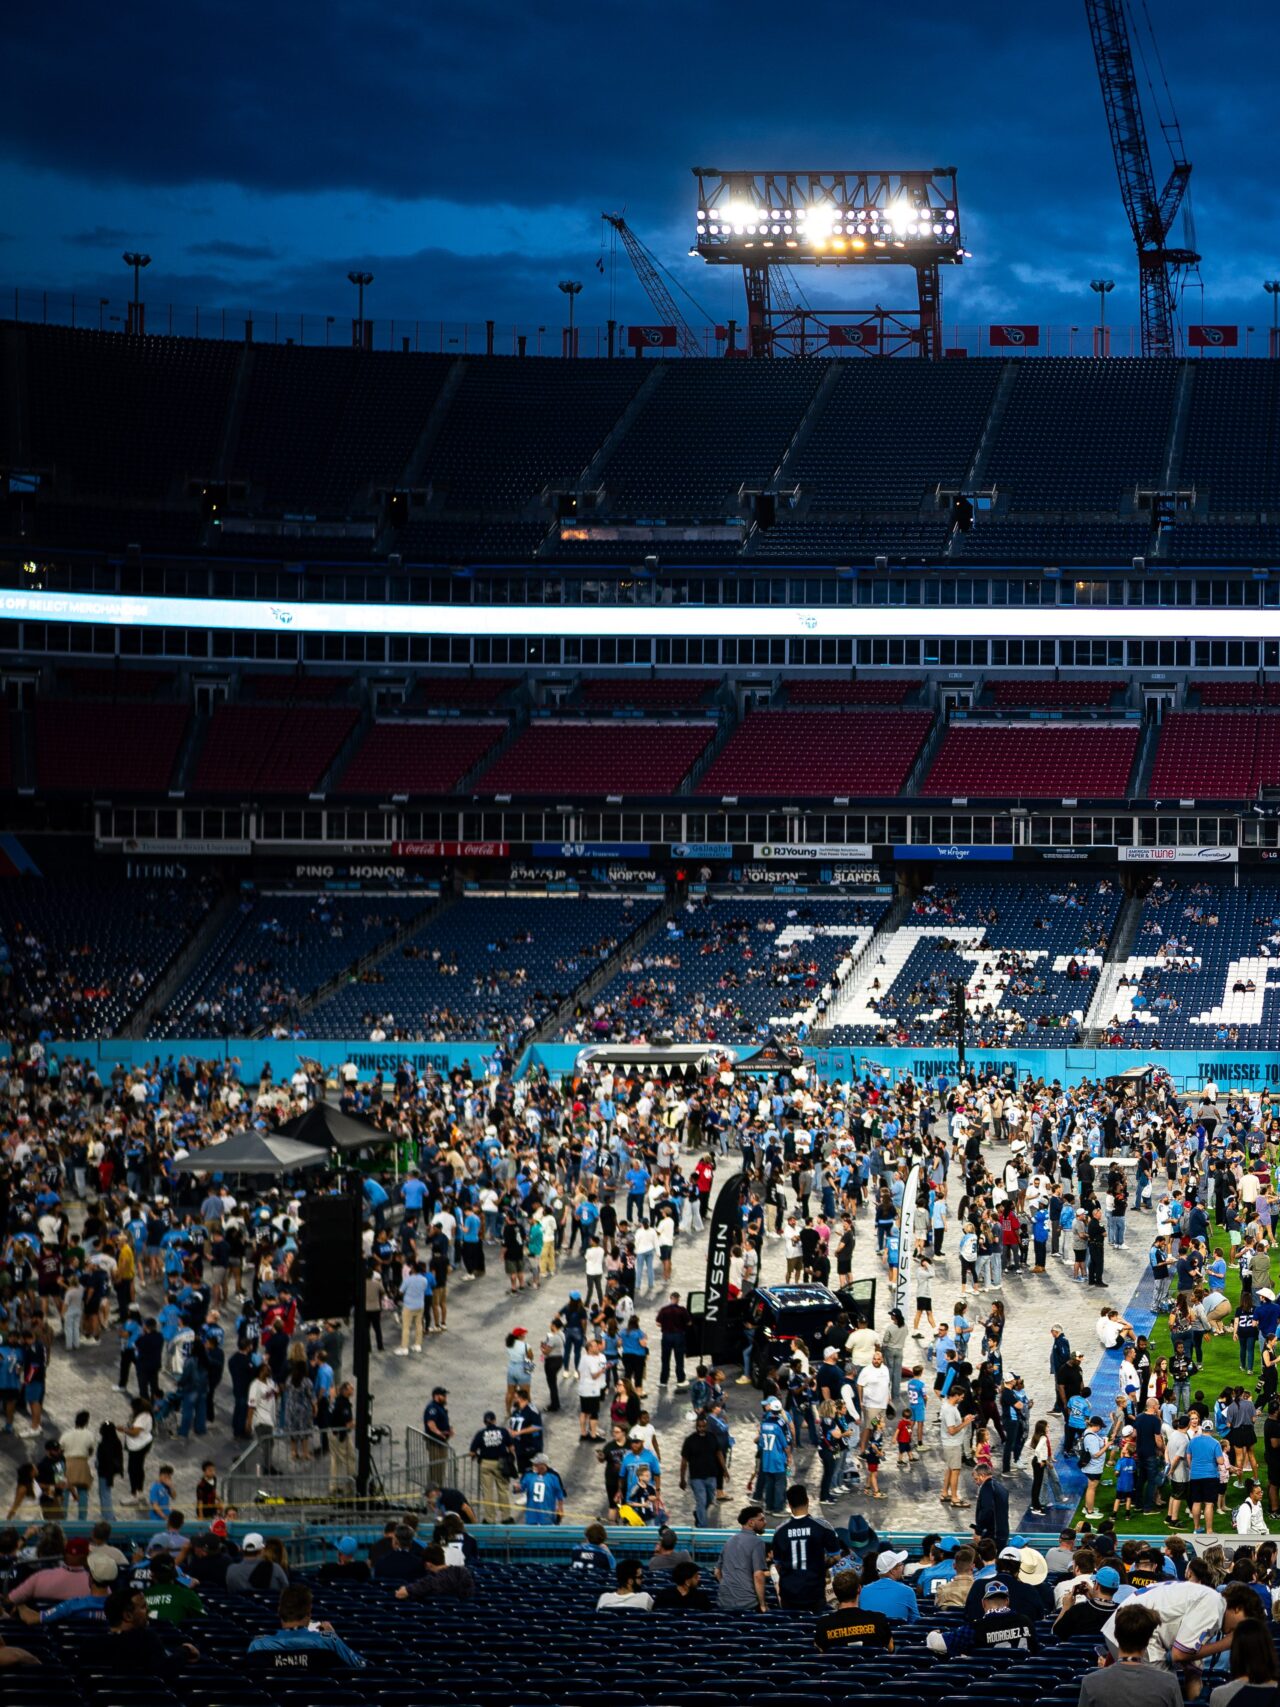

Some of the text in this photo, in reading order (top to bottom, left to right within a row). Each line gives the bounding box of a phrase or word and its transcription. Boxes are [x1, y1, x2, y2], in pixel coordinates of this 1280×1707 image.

[6, 598, 27, 610] OFF
[29, 599, 67, 612] SELECT
[405, 843, 436, 855] Coca-Cola
[463, 843, 494, 855] Coca-Cola
[774, 846, 817, 857] RJYoung
[947, 846, 970, 860] Kroger
[349, 865, 405, 879] HONOR
[835, 864, 880, 872] GEORGE
[347, 1053, 449, 1071] TENNESSEE TOUGH
[913, 1060, 975, 1077] TENNESSEE
[1198, 1063, 1260, 1081] TENNESSEE
[895, 1211, 911, 1306] NISSAN
[705, 1223, 729, 1322] NISSAN
[532, 1481, 545, 1503] 9
[787, 1527, 811, 1538] BROWN
[791, 1539, 807, 1570] 11
[1131, 1576, 1157, 1587] PICKE
[826, 1624, 876, 1640] ROETHLISBERGER
[986, 1627, 1021, 1644] RODRIGUEZ
[274, 1654, 308, 1667] McNAIR
